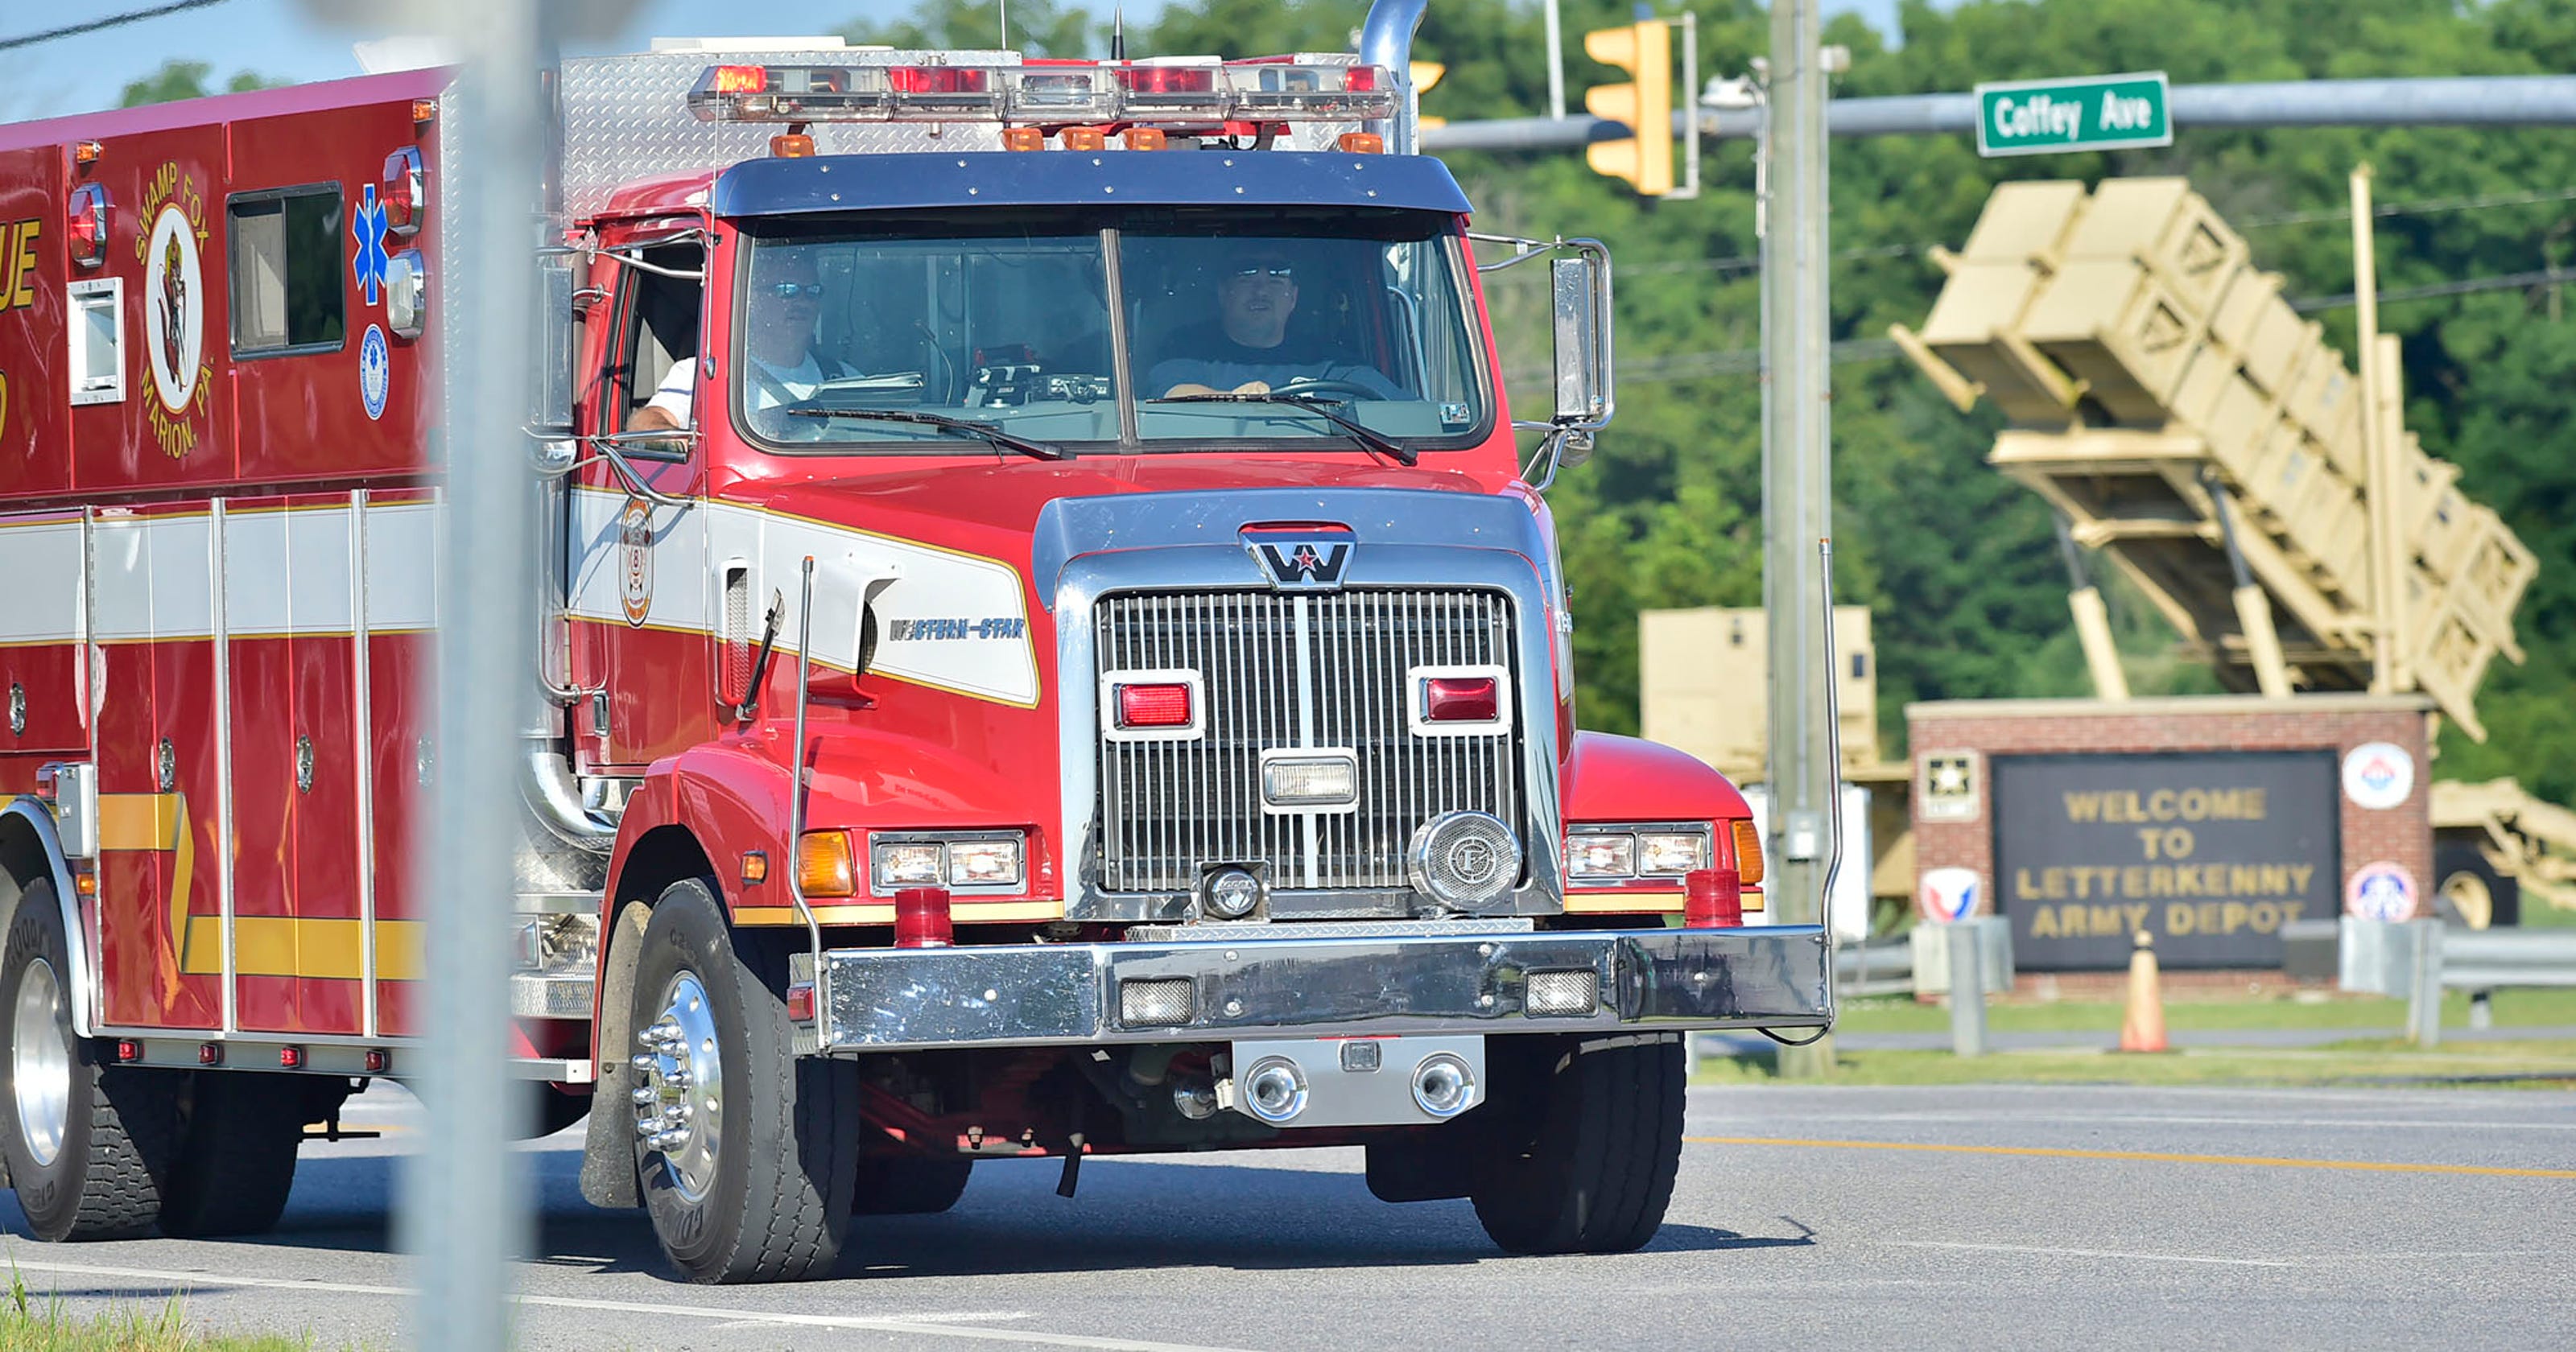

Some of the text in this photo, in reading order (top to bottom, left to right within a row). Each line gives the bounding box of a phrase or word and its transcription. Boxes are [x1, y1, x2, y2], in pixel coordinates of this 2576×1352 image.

[1994, 89, 2153, 141] Coffey Ave
[135, 161, 210, 266] SWAMP FOX
[2063, 788, 2267, 823] WELCOME
[2136, 827, 2194, 860] TO
[2015, 864, 2314, 901] LETTERKENNY
[2029, 901, 2151, 938] ARMY
